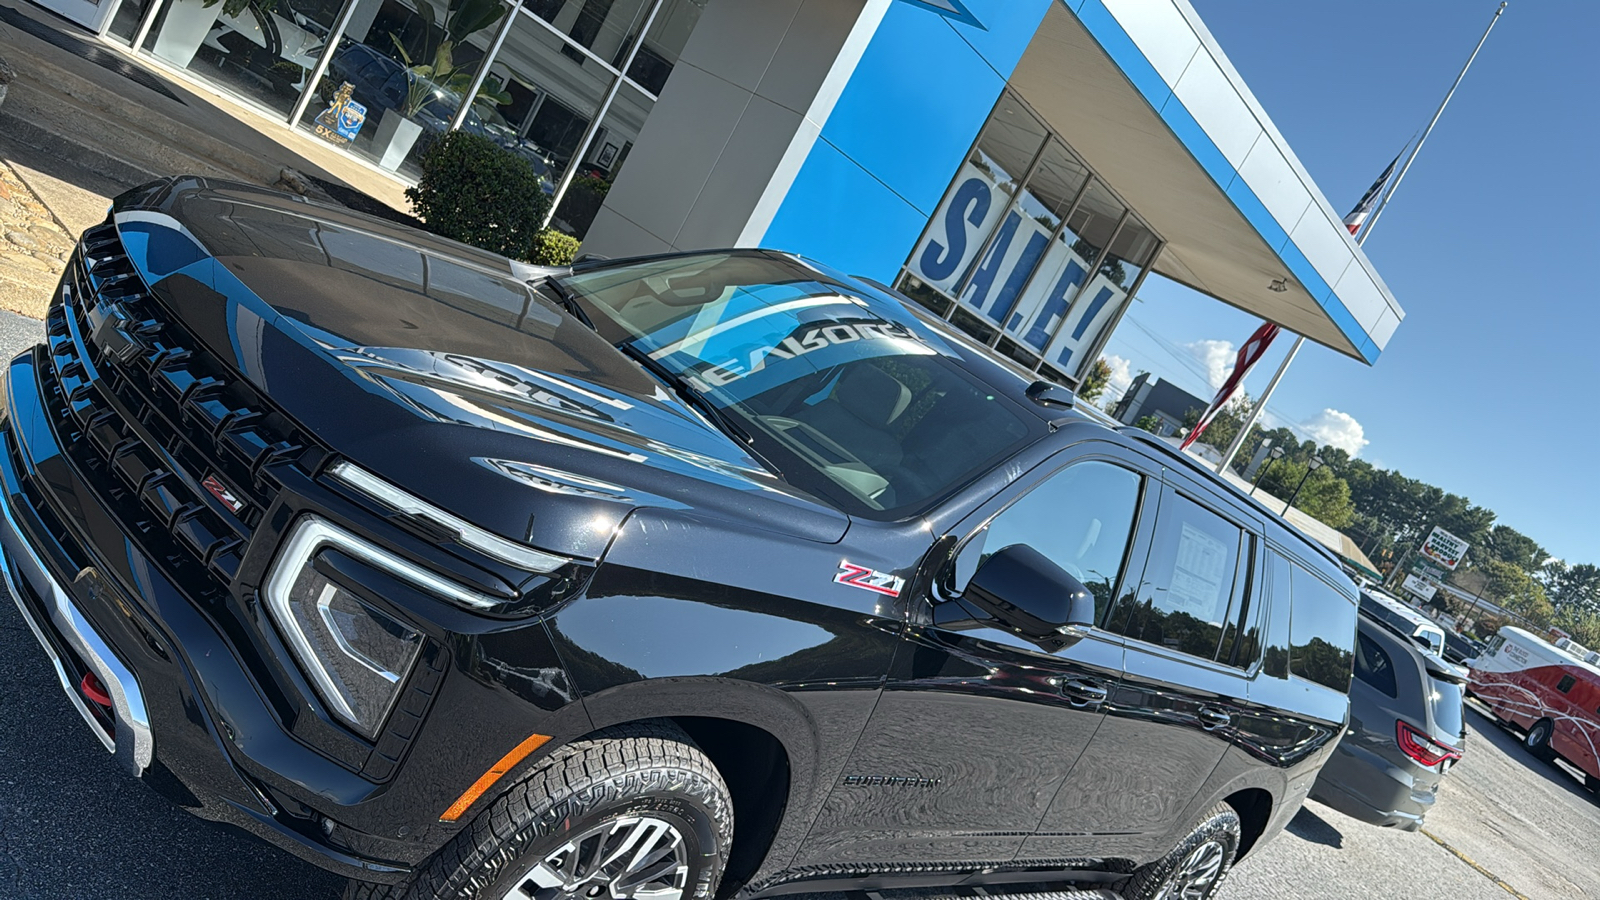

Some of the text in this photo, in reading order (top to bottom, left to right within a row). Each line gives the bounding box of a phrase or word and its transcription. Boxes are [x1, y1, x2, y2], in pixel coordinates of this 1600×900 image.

[315, 124, 333, 138] 5X
[919, 177, 1115, 368] SALE!
[202, 476, 243, 512] Z71
[1431, 538, 1460, 556] HARVEST
[1432, 532, 1459, 548] HEALTHY
[1430, 544, 1459, 563] PRODUCE
[833, 560, 906, 598] Z71
